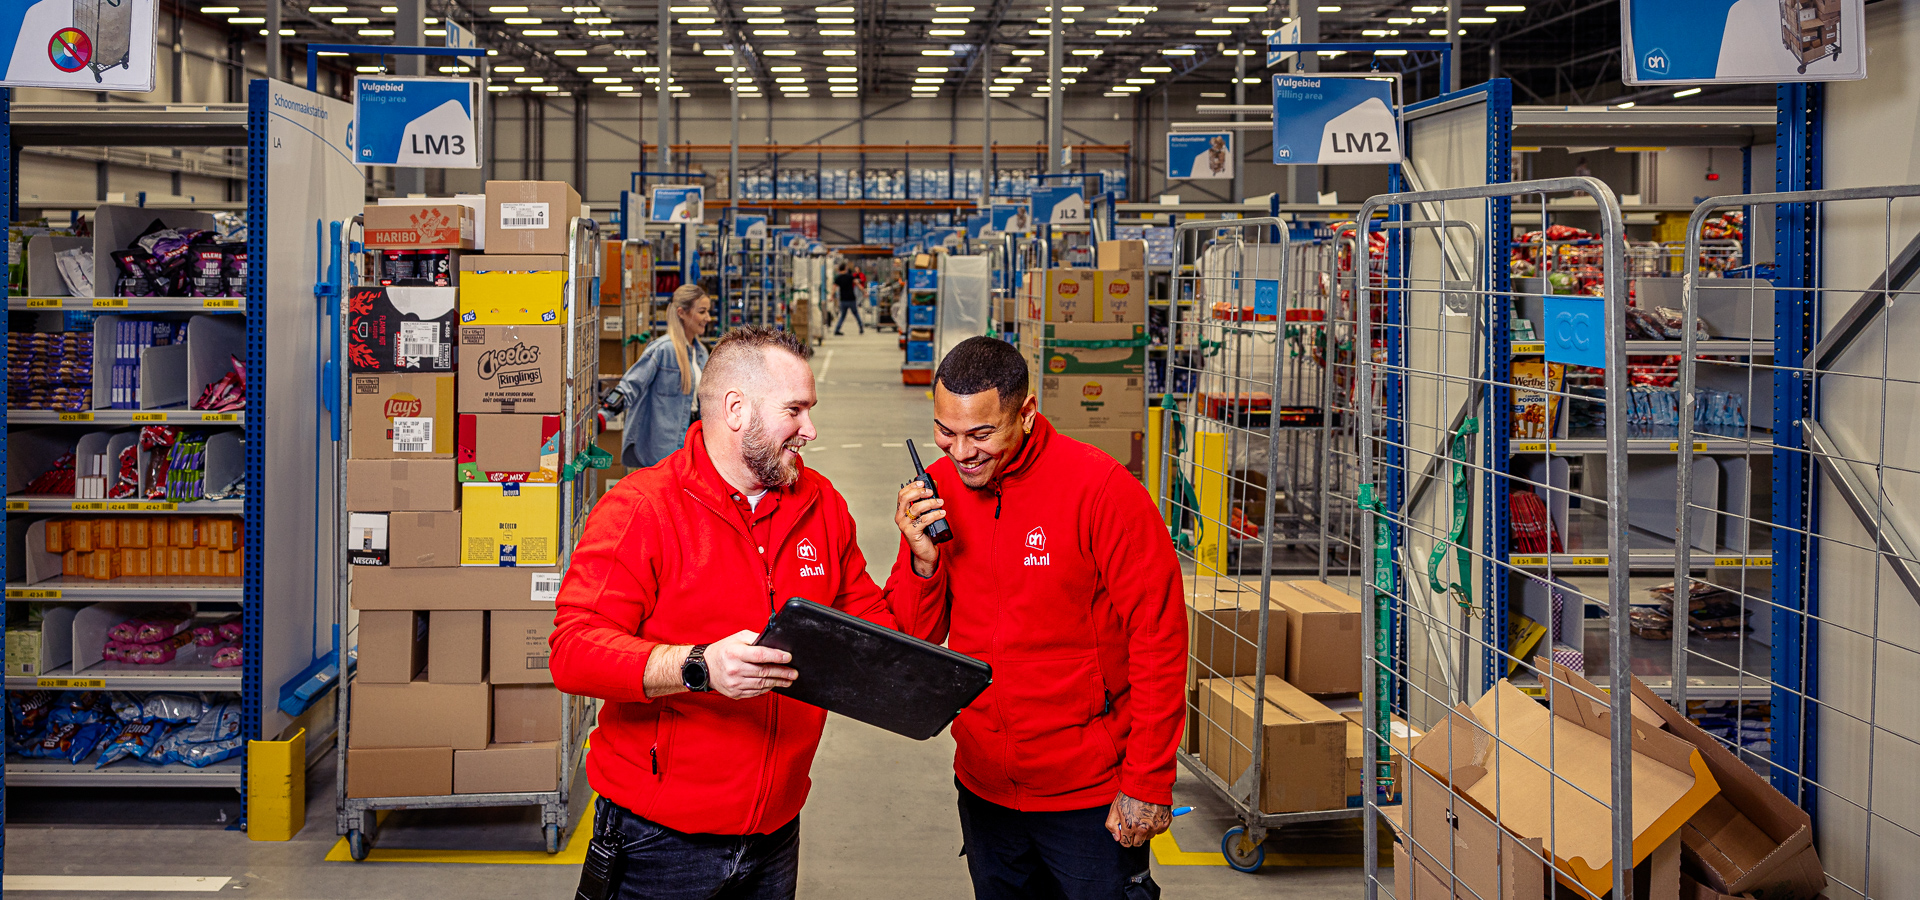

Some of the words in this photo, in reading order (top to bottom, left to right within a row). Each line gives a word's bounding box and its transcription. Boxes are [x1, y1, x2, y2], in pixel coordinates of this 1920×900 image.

[362, 83, 404, 93] Vulgebied
[1276, 78, 1321, 89] Vulgebied
[361, 94, 386, 104] Filling
[1277, 90, 1303, 101] Filling
[274, 93, 328, 120] Schoonmaakstation
[273, 137, 282, 148] LA
[411, 134, 466, 155] LM3
[1331, 132, 1392, 153] LM2
[1060, 209, 1077, 219] JL2
[376, 232, 417, 243] HARIBO
[1059, 300, 1077, 310] light
[1110, 300, 1128, 310] light
[462, 313, 475, 322] TUC
[542, 313, 555, 322] TUC
[1554, 311, 1589, 352] CC
[478, 342, 539, 380] Cheetos
[499, 371, 539, 385] Ringlings
[386, 399, 420, 417] Lay's
[509, 472, 524, 481] MIX
[1023, 552, 1050, 566] ah.nl
[799, 563, 825, 577] ah.nl
